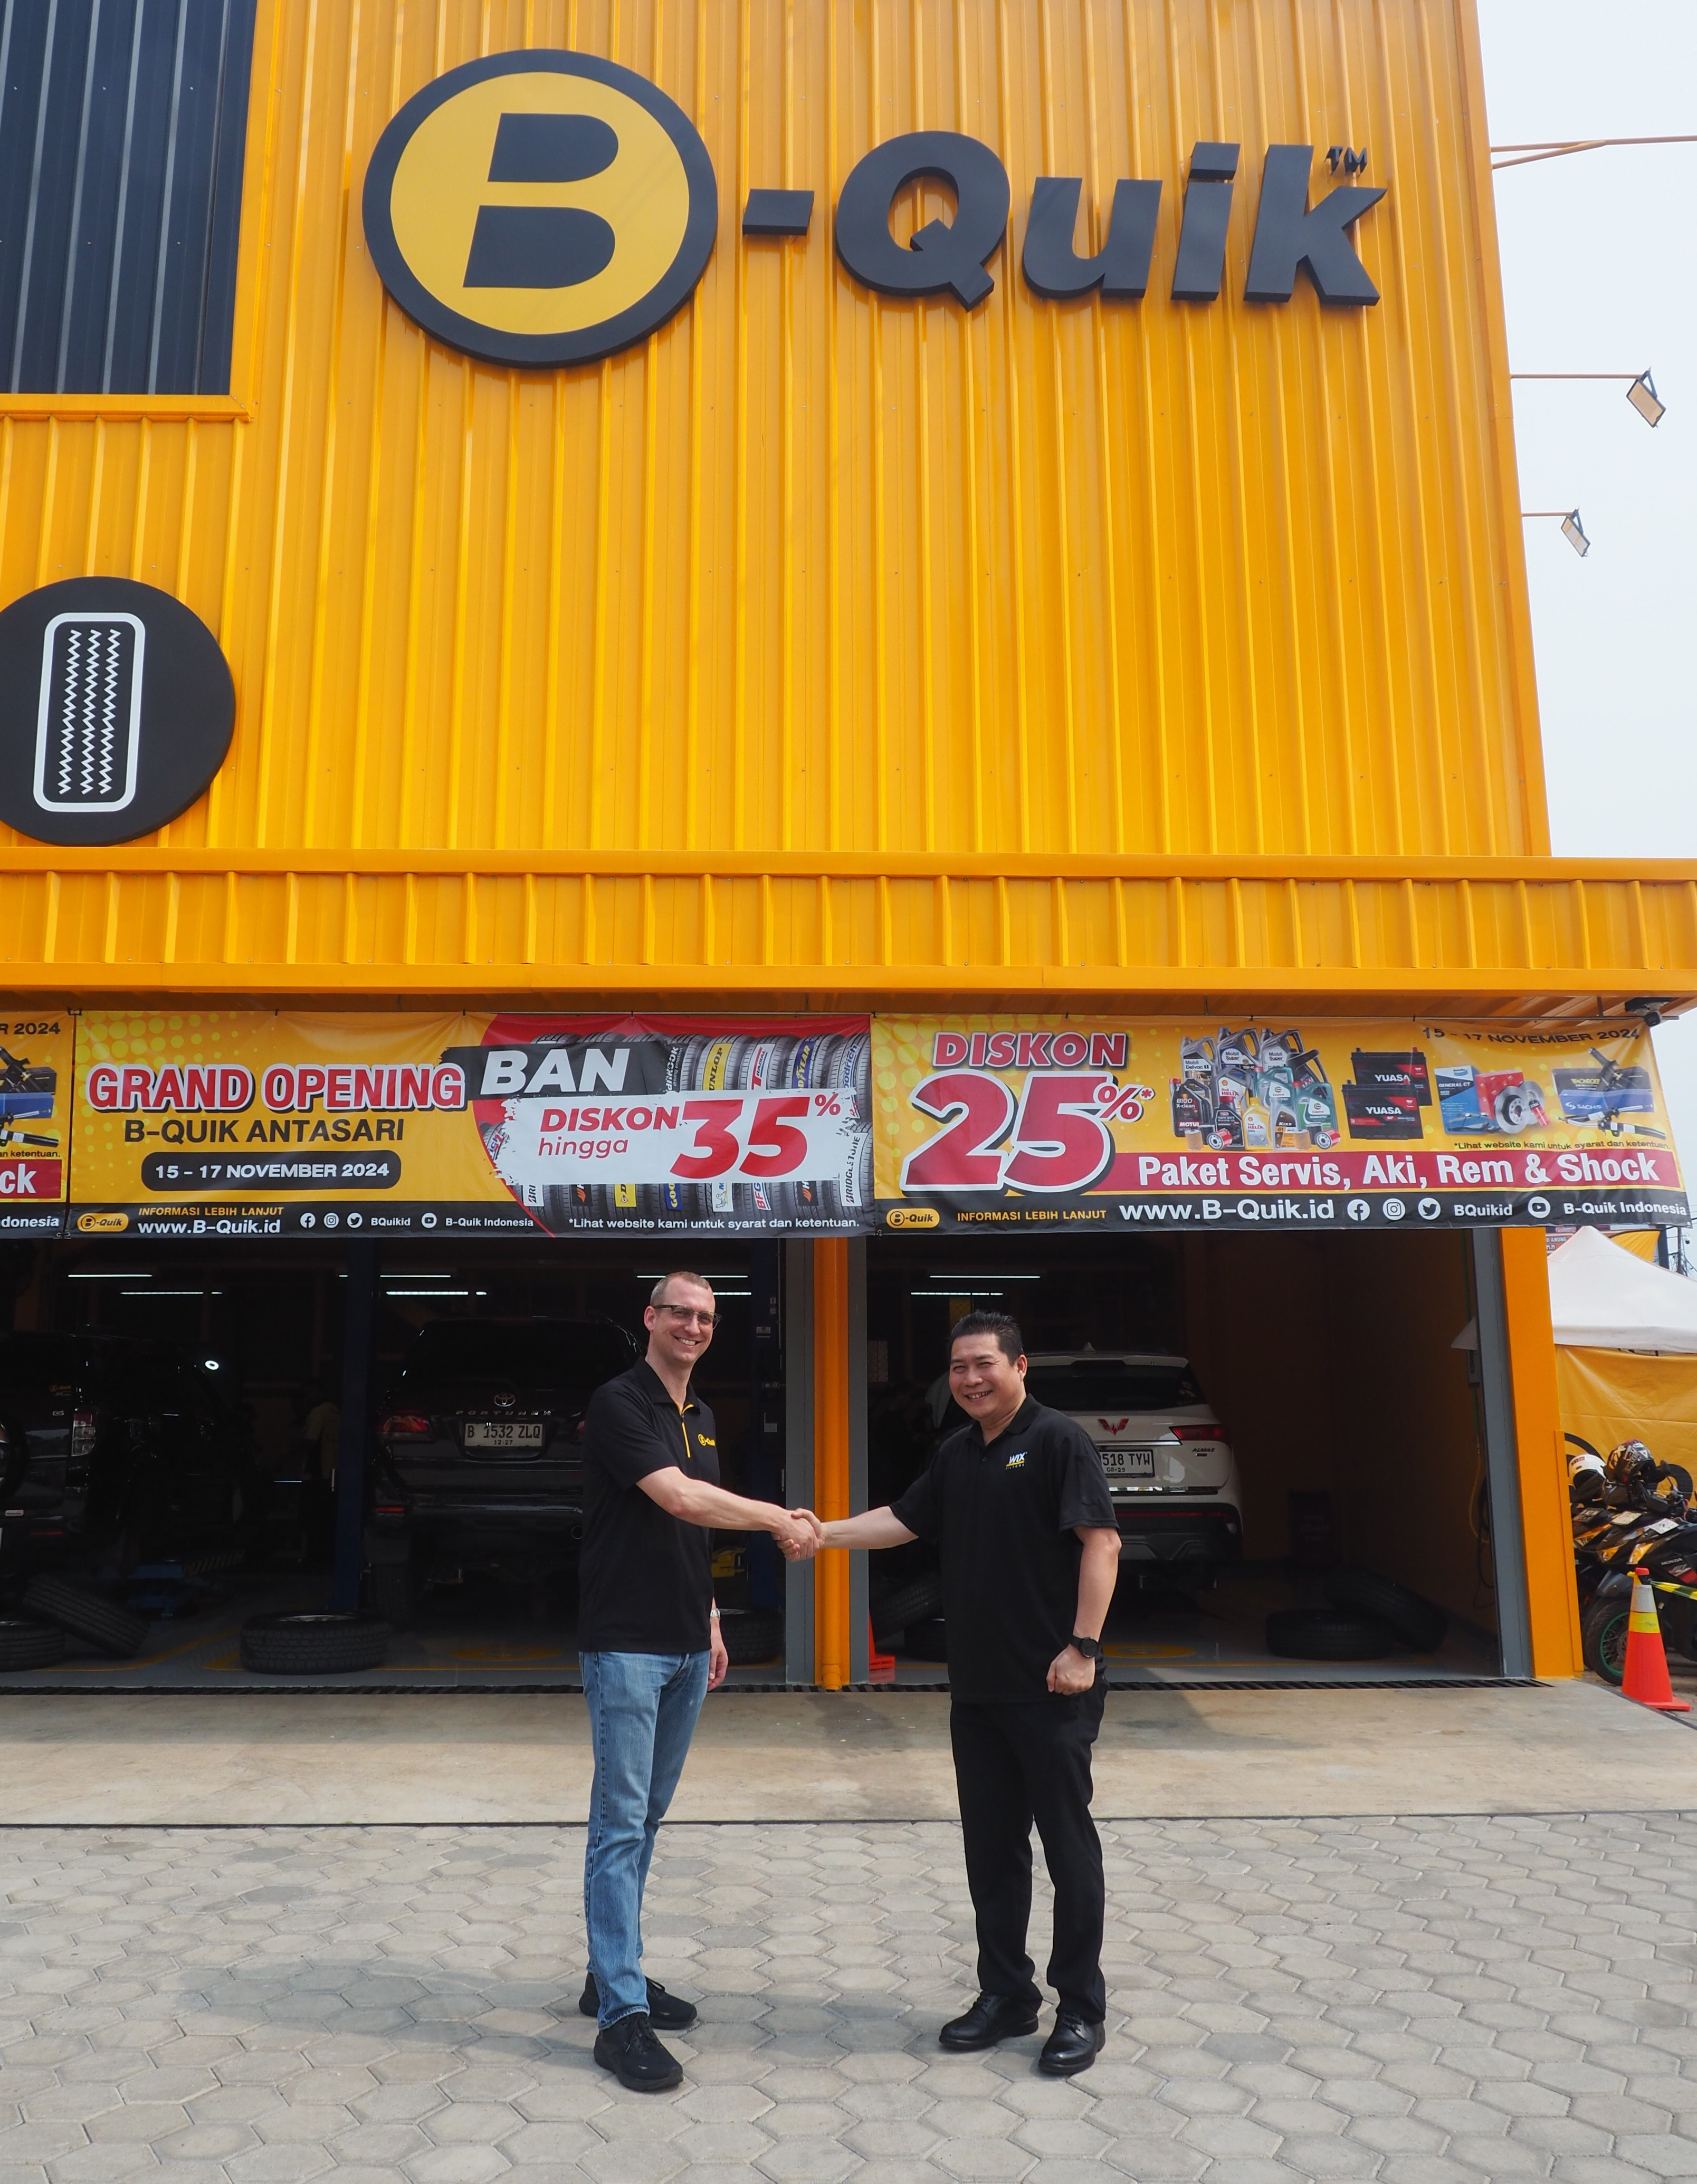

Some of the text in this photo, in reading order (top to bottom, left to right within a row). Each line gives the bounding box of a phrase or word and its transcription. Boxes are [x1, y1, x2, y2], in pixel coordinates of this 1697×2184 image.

[14, 1022, 61, 1034] 2024
[1423, 1027, 1445, 1039] 15
[1488, 1033, 1593, 1043] NOVEMBER
[1597, 1029, 1639, 1040] 2024
[933, 1032, 1127, 1068] DISKON
[480, 1049, 630, 1095] BAN
[709, 1047, 723, 1090] UNLOP
[87, 1064, 465, 1110] GRAND OPENING
[540, 1106, 680, 1132] DISKON
[125, 1118, 404, 1145] B-QUIK ANTASARI
[538, 1136, 629, 1159] hingga
[1575, 1140, 1605, 1149] syarat
[1626, 1140, 1671, 1150] ketentuan.
[155, 1165, 179, 1179] 15
[199, 1165, 222, 1179] 17
[226, 1164, 337, 1178] NOVEMBER
[341, 1163, 389, 1177] 2024
[1139, 1152, 1661, 1190] Paket Servis, Aki, Rem & Shock
[138, 1206, 284, 1216] INFORMASI LEBIH LANJUT
[957, 1211, 1021, 1222] INFORMASI
[1025, 1211, 1059, 1220] LEBIH
[1063, 1210, 1107, 1220] LANJUT
[1119, 1199, 1687, 1221] www.B-Quik.id BQuikid B-Quik Indonesia
[0, 1216, 59, 1228] donesia
[138, 1219, 281, 1234] www.B-Quik.id
[370, 1217, 534, 1227] BQuikid B-Quik Indonesia
[607, 1218, 655, 1228] website
[658, 1219, 688, 1228] kami
[691, 1219, 725, 1229] untuk
[728, 1219, 766, 1231] syarat
[769, 1218, 793, 1228] dan
[795, 1218, 860, 1228] ketentuan.
[467, 1425, 541, 1439] B 1532 ZLQ
[1102, 1453, 1150, 1465] 518 TYW
